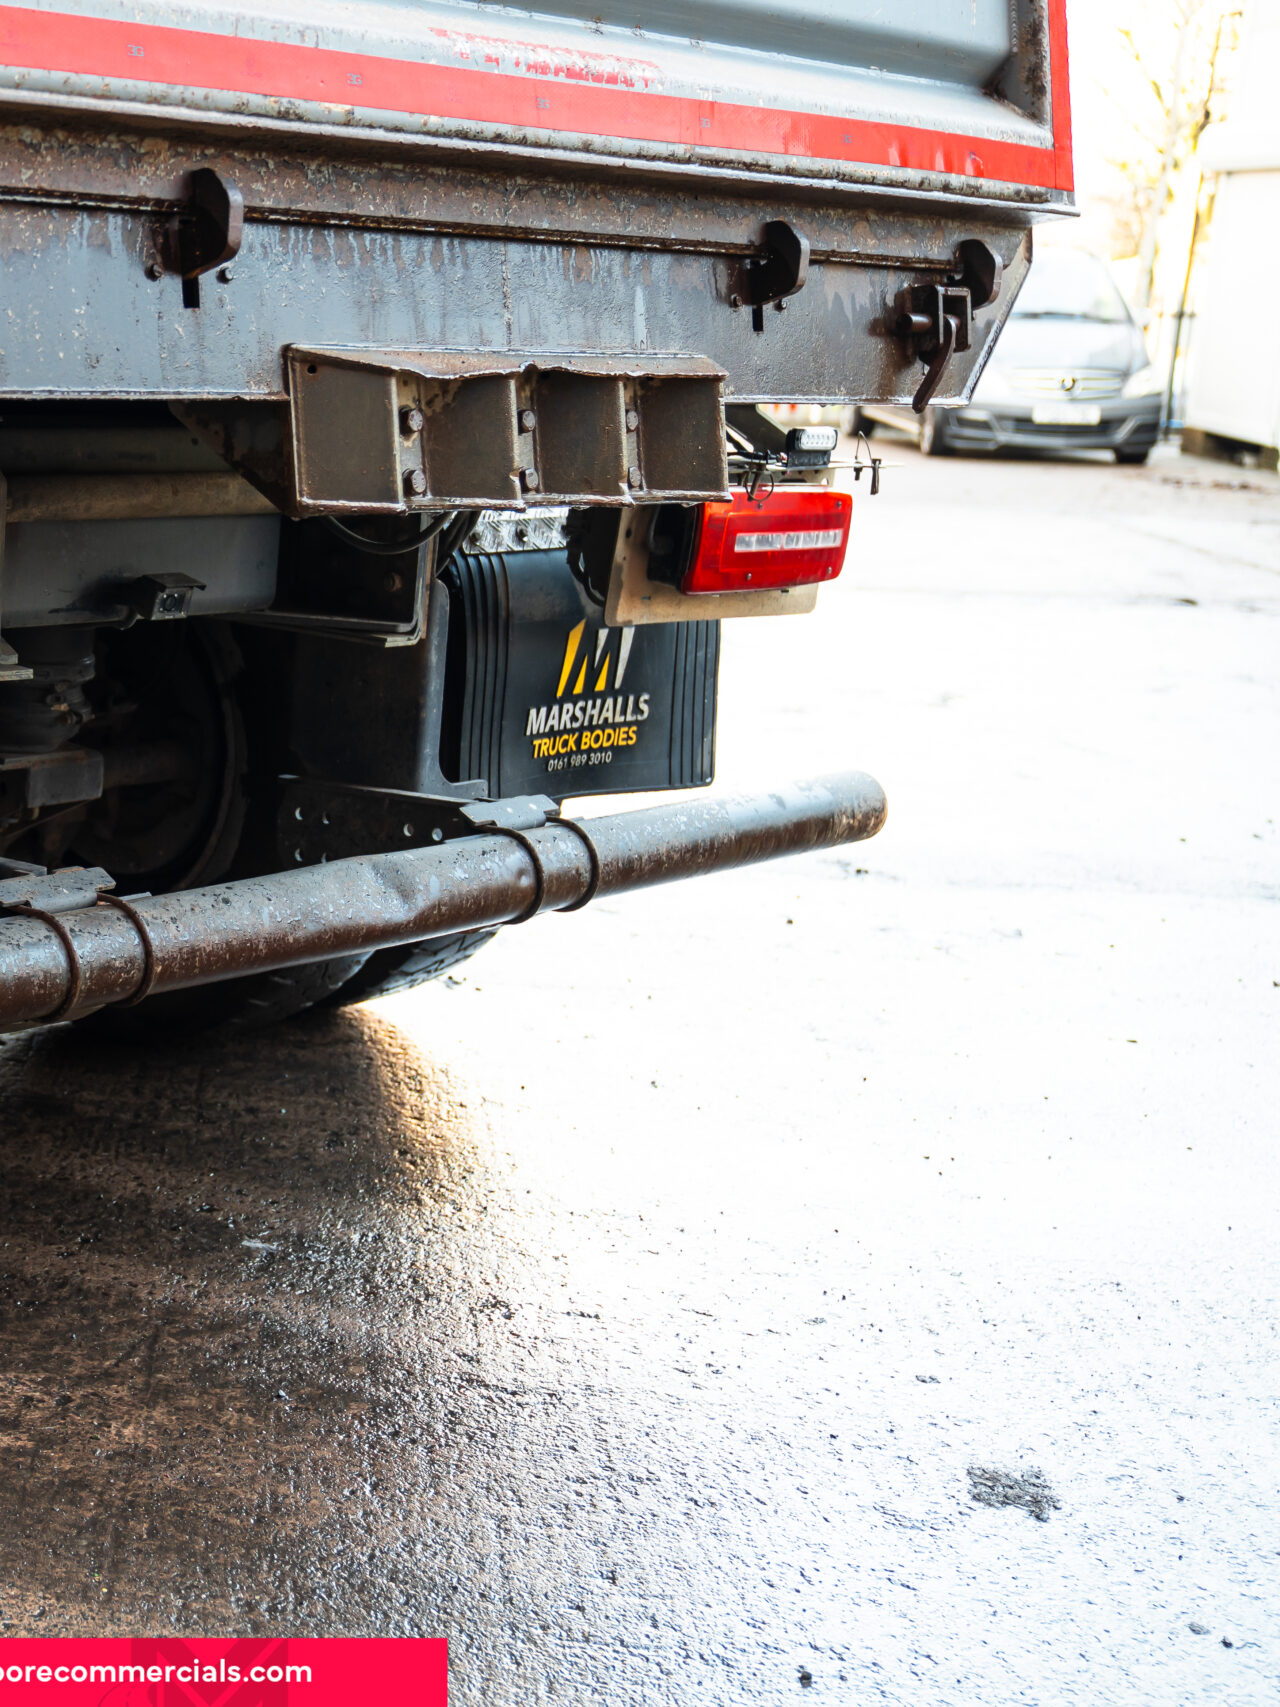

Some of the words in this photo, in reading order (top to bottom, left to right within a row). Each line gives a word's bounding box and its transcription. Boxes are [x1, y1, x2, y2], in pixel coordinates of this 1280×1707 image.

[525, 693, 651, 736] MARSHALLS
[532, 732, 578, 758] TRUCK
[580, 726, 638, 750] BODIES
[547, 758, 568, 772] 0161
[570, 755, 587, 767] 989
[588, 751, 612, 765] 3010
